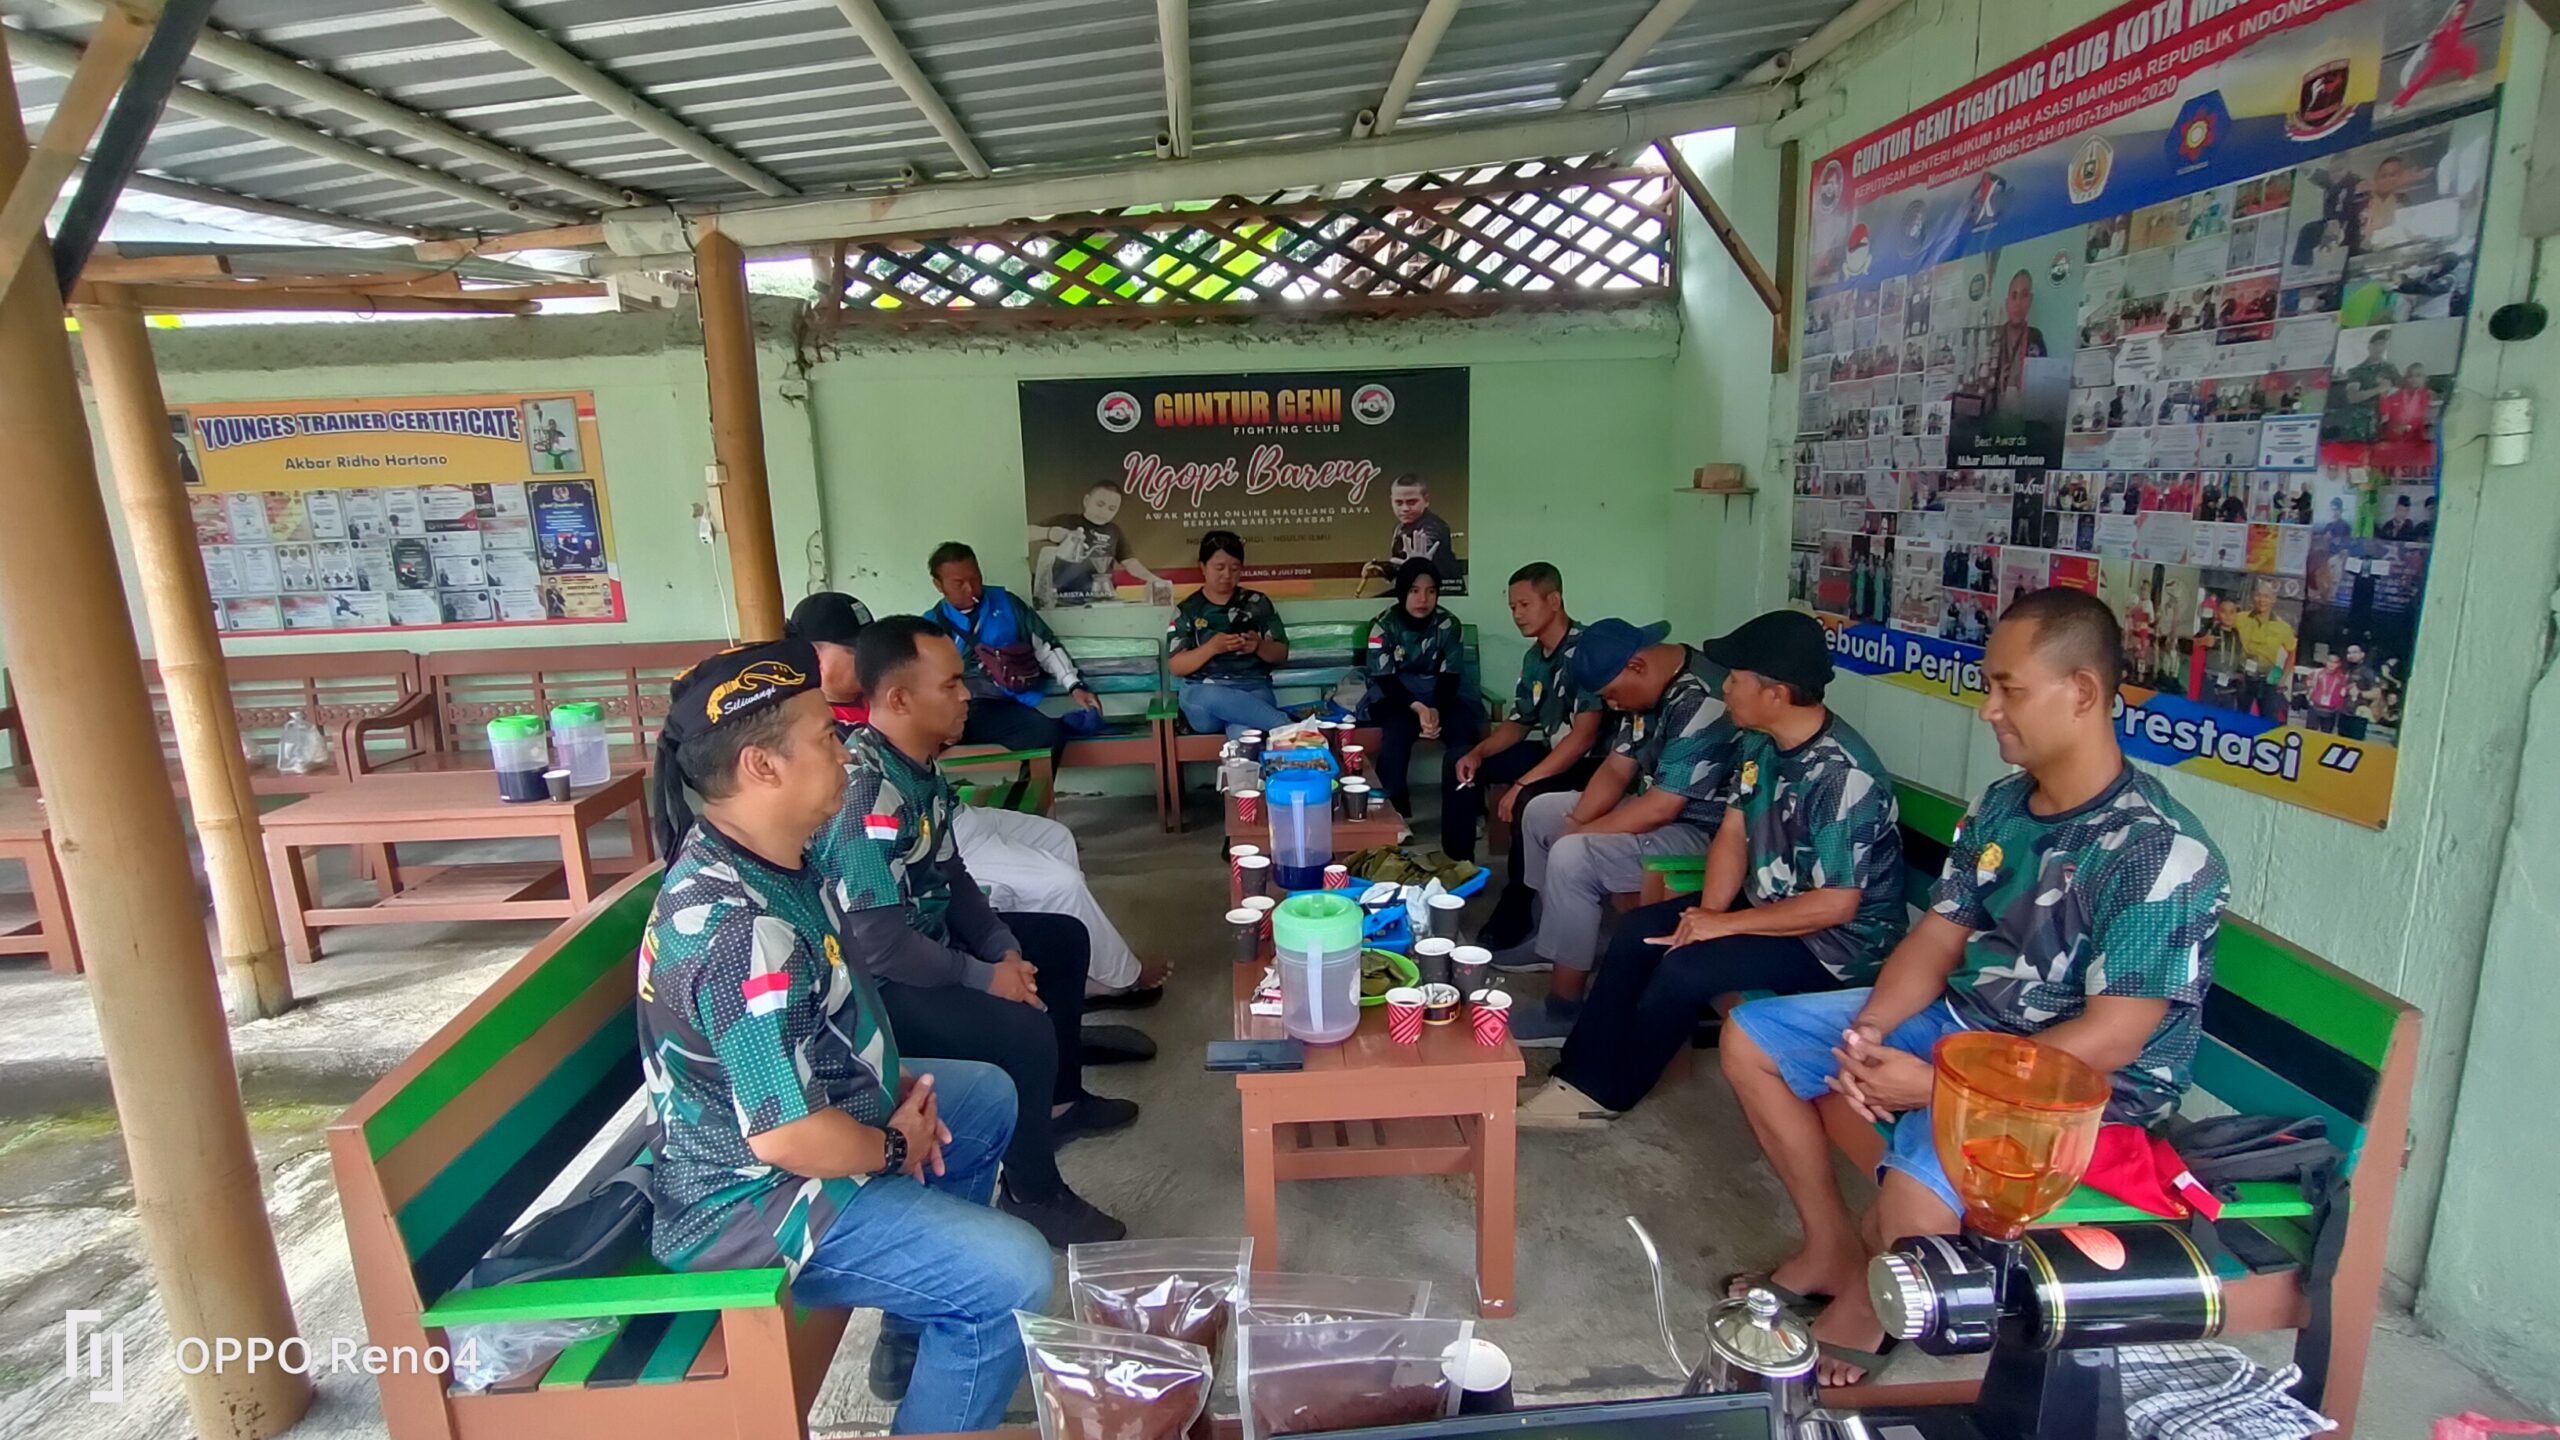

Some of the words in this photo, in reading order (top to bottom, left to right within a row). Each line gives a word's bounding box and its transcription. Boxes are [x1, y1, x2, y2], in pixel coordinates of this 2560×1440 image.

[1852, 127, 1911, 178] GUNTUR
[1914, 106, 1952, 150] GENI
[1954, 61, 2046, 133] FIGHTING
[2050, 30, 2110, 89] CLUB
[2113, 0, 2183, 62] KOTA
[1854, 168, 1906, 199] KEPUTUSAN
[1908, 150, 1951, 177] MENTERI
[1952, 132, 1993, 159] HUKUM
[2004, 113, 2032, 137] HAK
[2033, 98, 2073, 124] ASASI
[2076, 70, 2143, 107] MANUSIA
[2147, 26, 2235, 74] REPUBLIK
[1154, 390, 1270, 427] GUNTUR
[1277, 388, 1342, 424] GENI
[199, 415, 296, 449] YOUNGES
[299, 413, 387, 433] TRAINER
[390, 409, 520, 440] CERTIFICATE
[1233, 426, 1300, 436] FIGHTING
[1304, 424, 1341, 434] CLUB
[285, 458, 331, 470] Akbar
[337, 455, 380, 467] Ridho
[385, 454, 448, 466] Hartono
[1123, 450, 1239, 511] Ngopi
[1245, 443, 1381, 504] Bareng
[1145, 512, 1179, 521] AWAK
[1183, 510, 1220, 519] MEDIA
[1225, 509, 1267, 518] ONLINE
[1273, 507, 1335, 517] MAGELANG
[1183, 519, 1237, 528] BERSAMA
[1241, 517, 1291, 526] BARISTA
[1818, 617, 1895, 668] ebuah
[1905, 641, 1990, 694] Perja
[724, 684, 776, 715] Siliwangi
